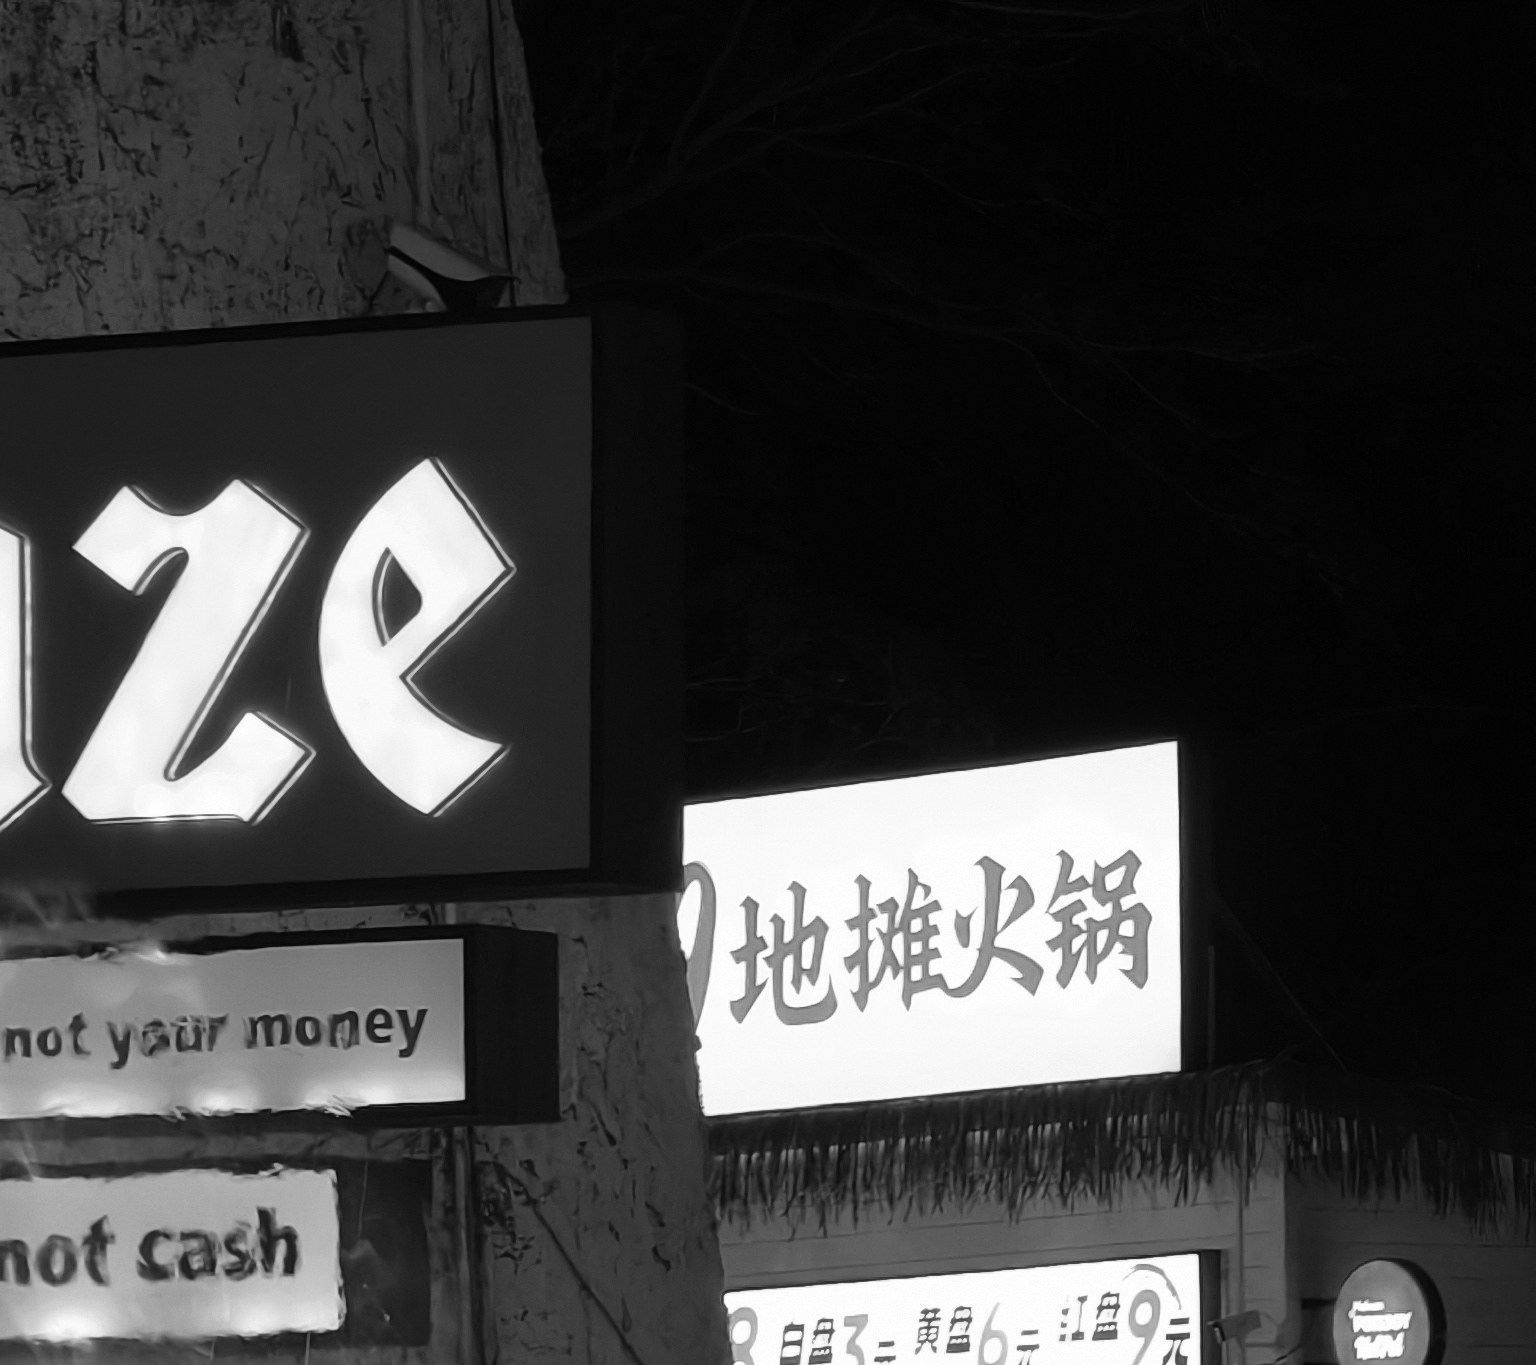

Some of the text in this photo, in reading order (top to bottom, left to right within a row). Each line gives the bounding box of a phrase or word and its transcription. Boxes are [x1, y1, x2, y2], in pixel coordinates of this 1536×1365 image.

[729, 849, 1152, 1025] 地摊火锅
[4, 1012, 91, 1062] not
[106, 1013, 228, 1070] your
[245, 1007, 428, 1058] money
[136, 1206, 302, 1281] cash
